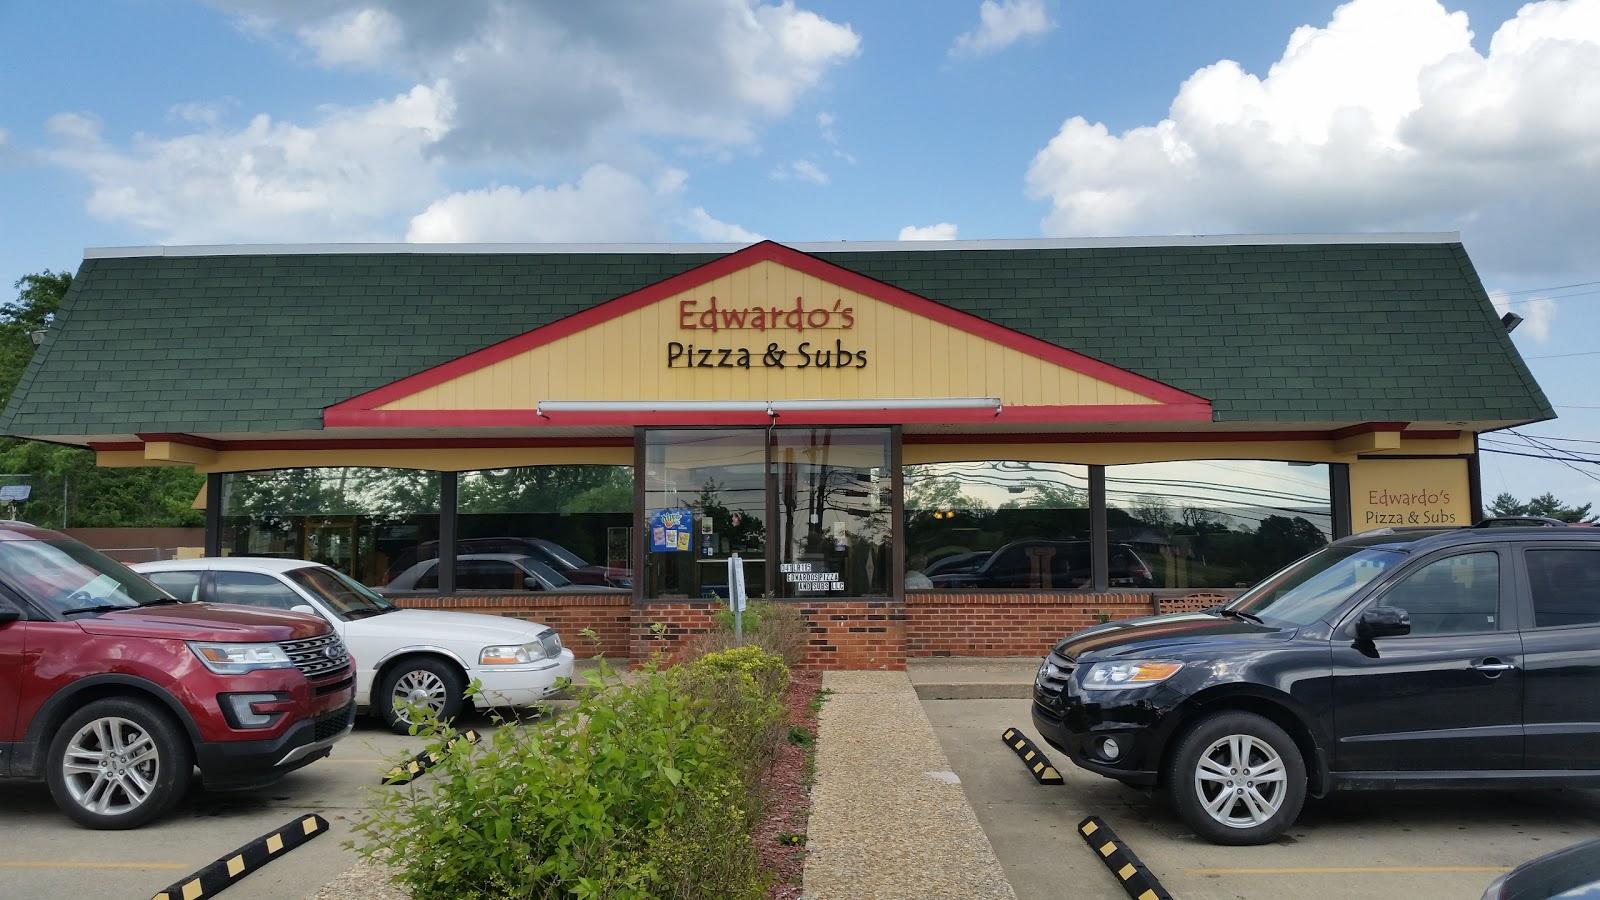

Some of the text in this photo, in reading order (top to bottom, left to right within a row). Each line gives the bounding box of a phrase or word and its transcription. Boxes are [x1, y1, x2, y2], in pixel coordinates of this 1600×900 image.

[680, 296, 854, 332] Edwardo's
[668, 339, 868, 369] Pizza & Subs
[1369, 489, 1450, 506] Edwardo's
[1366, 509, 1456, 524] Pizza & Subs
[799, 582, 844, 591] AND SUBS LLC
